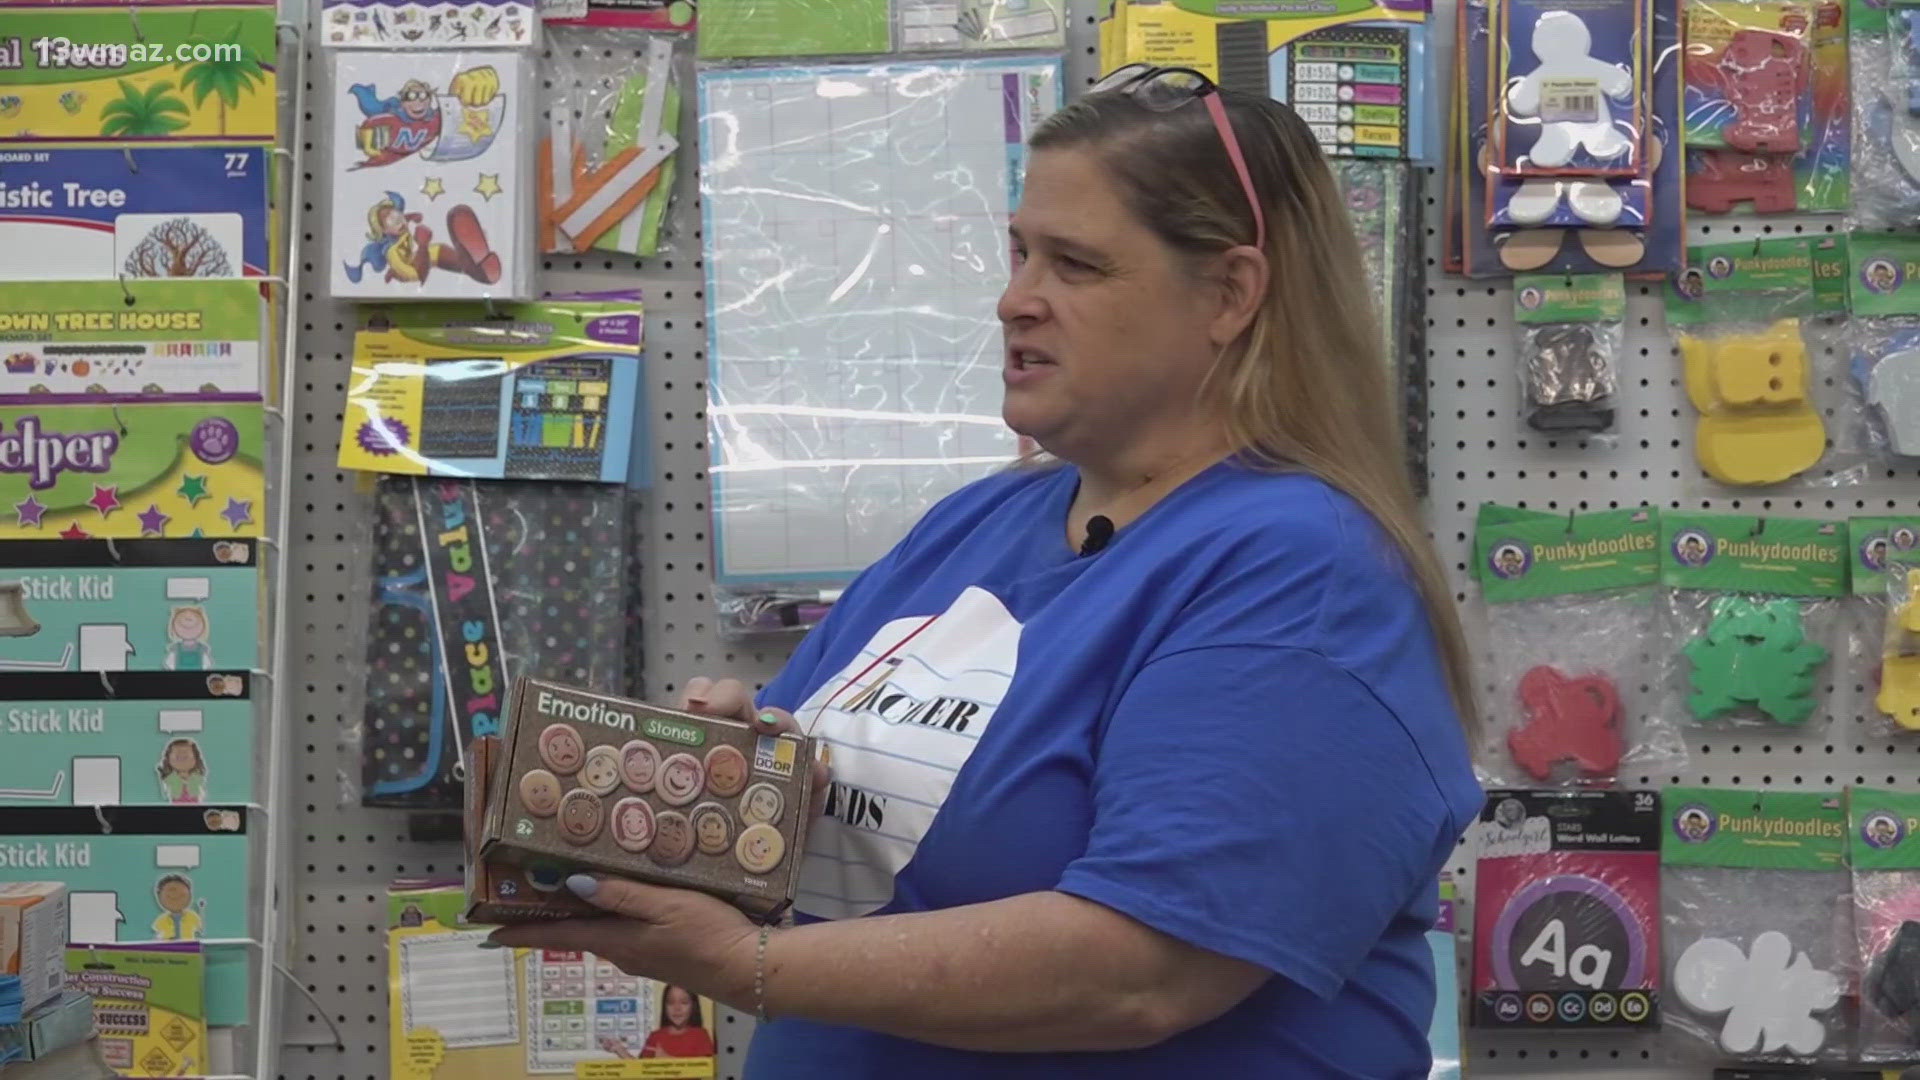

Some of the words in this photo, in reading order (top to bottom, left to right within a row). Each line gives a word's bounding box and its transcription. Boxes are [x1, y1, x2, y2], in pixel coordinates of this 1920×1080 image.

[34, 153, 50, 163] SET
[224, 153, 249, 170] 77
[0, 182, 53, 207] istic
[63, 183, 126, 208] Tree
[1814, 260, 1842, 278] les
[54, 313, 115, 331] TREE
[119, 312, 201, 331] HOUSE
[0, 419, 113, 483] elper
[1533, 532, 1656, 563] Punkydoodles
[1716, 537, 1839, 563] Punkydoodles
[21, 576, 72, 600] Stick
[78, 576, 114, 600] Kid
[463, 620, 500, 737] Place
[8, 708, 61, 733] Stick
[68, 708, 104, 733] Kid
[537, 691, 636, 732] Emotion
[648, 720, 698, 742] Stones
[1634, 793, 1654, 806] 36
[1719, 814, 1842, 838] Punkydoodles
[0, 843, 48, 868] Stick
[55, 843, 90, 868] Kid
[1520, 918, 1612, 990] Aa
[81, 971, 151, 988] Construction
[99, 1012, 147, 1026] SUCCESS
